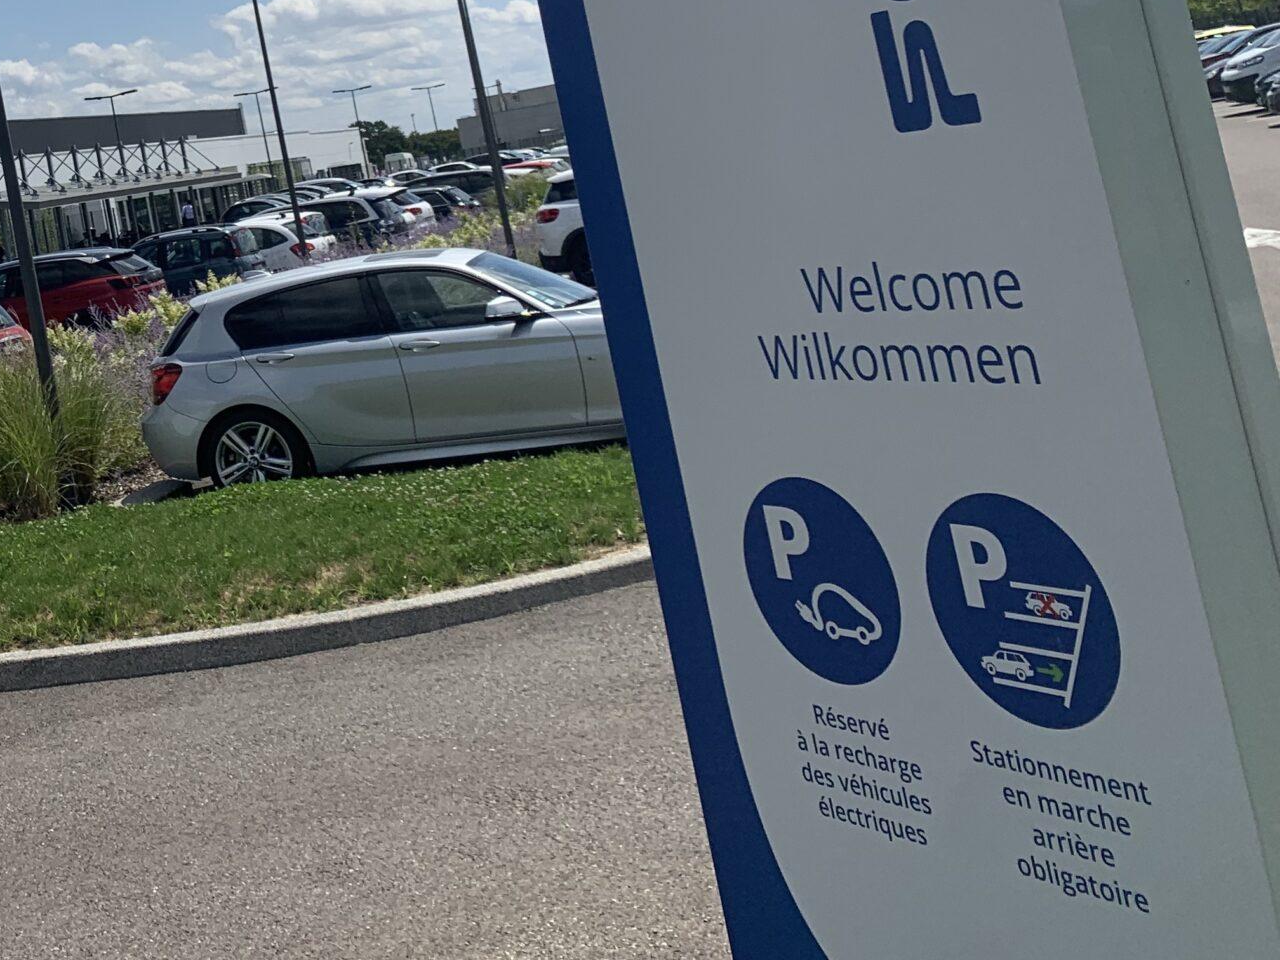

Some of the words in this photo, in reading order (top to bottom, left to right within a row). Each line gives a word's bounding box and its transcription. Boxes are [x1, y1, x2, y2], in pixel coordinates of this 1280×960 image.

[799, 260, 1024, 314] Welcome
[757, 331, 1042, 385] Wilkommen
[762, 504, 810, 580] P
[949, 523, 1007, 609] P
[811, 703, 891, 741] Réservé
[796, 728, 809, 752] à
[810, 732, 830, 758] la
[833, 744, 923, 784] recharge
[969, 740, 1153, 806] Stationnement
[801, 761, 835, 789] des
[836, 773, 933, 816] véhicules
[1002, 786, 1032, 810] en
[1037, 794, 1132, 837] marche
[818, 795, 928, 846] électriques
[1032, 828, 1116, 868] arrière
[1017, 854, 1150, 914] obligatoire
